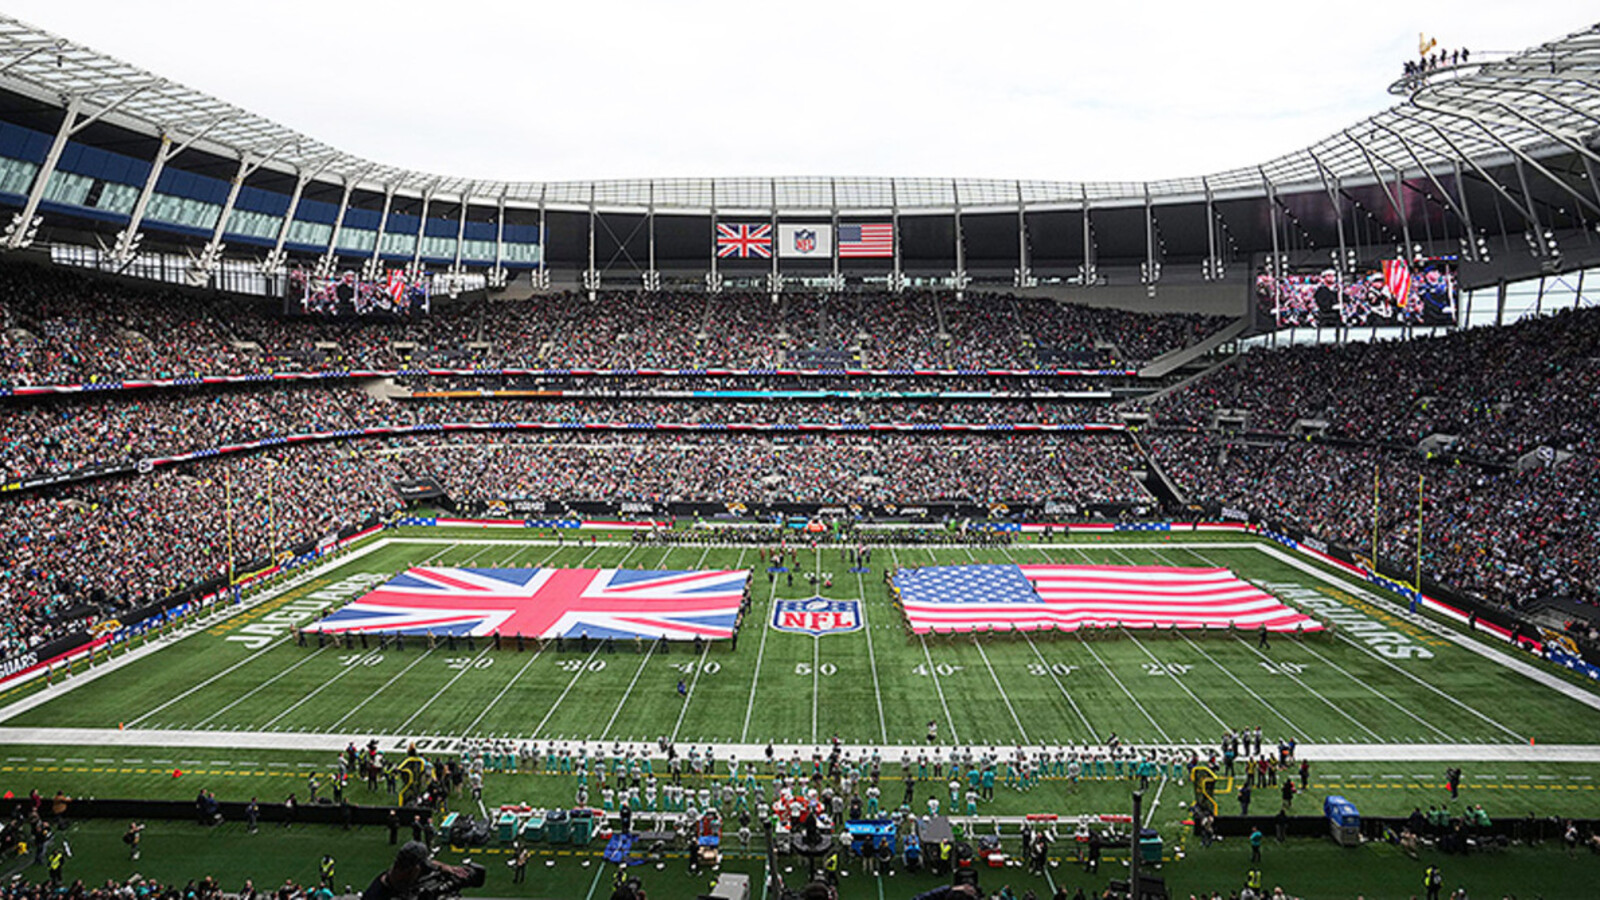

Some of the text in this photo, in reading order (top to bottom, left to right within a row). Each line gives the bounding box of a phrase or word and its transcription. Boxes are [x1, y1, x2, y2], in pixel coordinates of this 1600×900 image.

[225, 572, 392, 648] JAGUARS
[783, 611, 853, 630] NFL
[795, 662, 838, 675] 50
[911, 662, 954, 676] 40
[1026, 662, 1071, 676] 30
